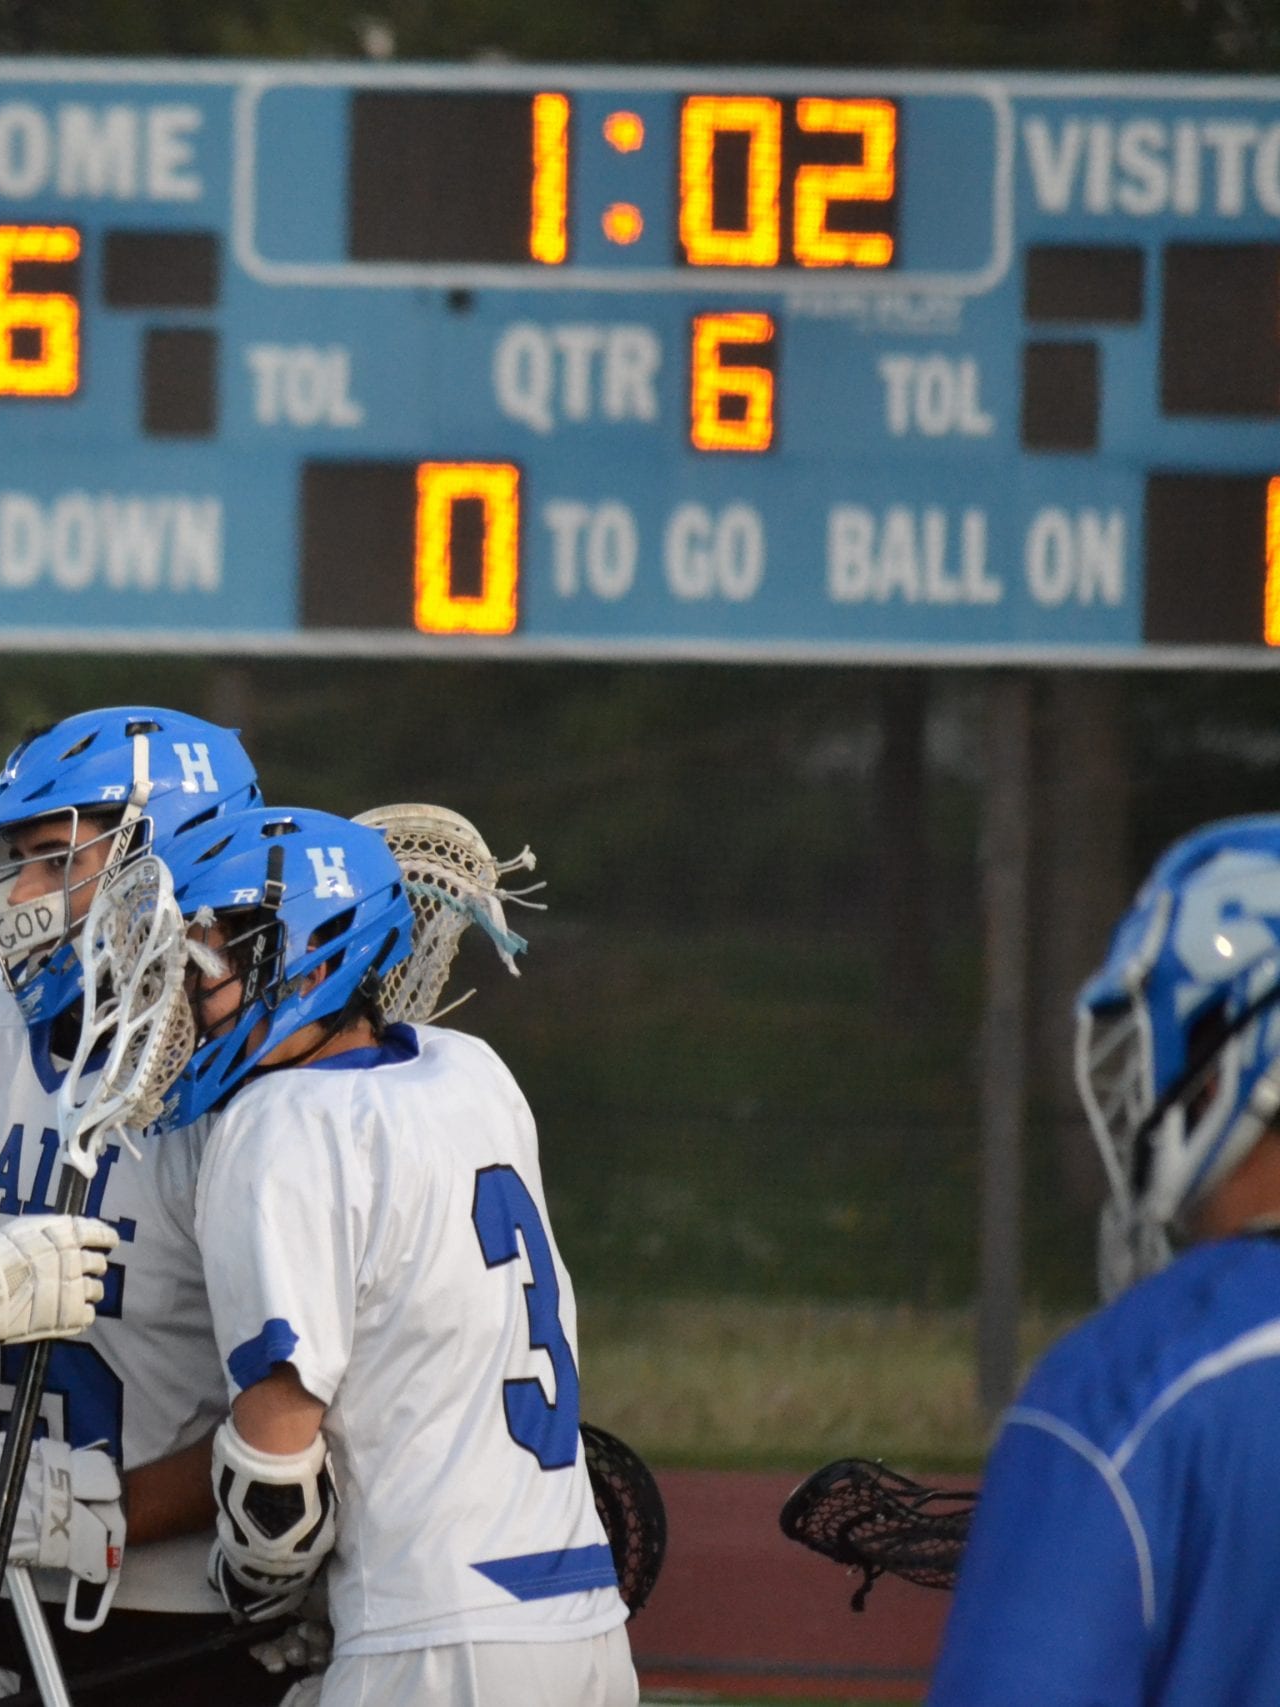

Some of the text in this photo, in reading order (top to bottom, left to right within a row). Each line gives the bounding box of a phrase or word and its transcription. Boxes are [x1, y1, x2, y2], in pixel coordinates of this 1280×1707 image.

[530, 92, 896, 268] 1:02
[245, 345, 364, 427] TOL
[492, 325, 660, 434] QTR
[691, 312, 774, 451] 6
[878, 354, 995, 437] TOL
[413, 460, 520, 634] 0
[542, 503, 765, 602] TO GO
[827, 510, 1126, 607] BALL ON
[172, 743, 219, 793] H
[306, 847, 354, 898] H
[471, 1163, 580, 1471] 3
[48, 1464, 72, 1539] STX
